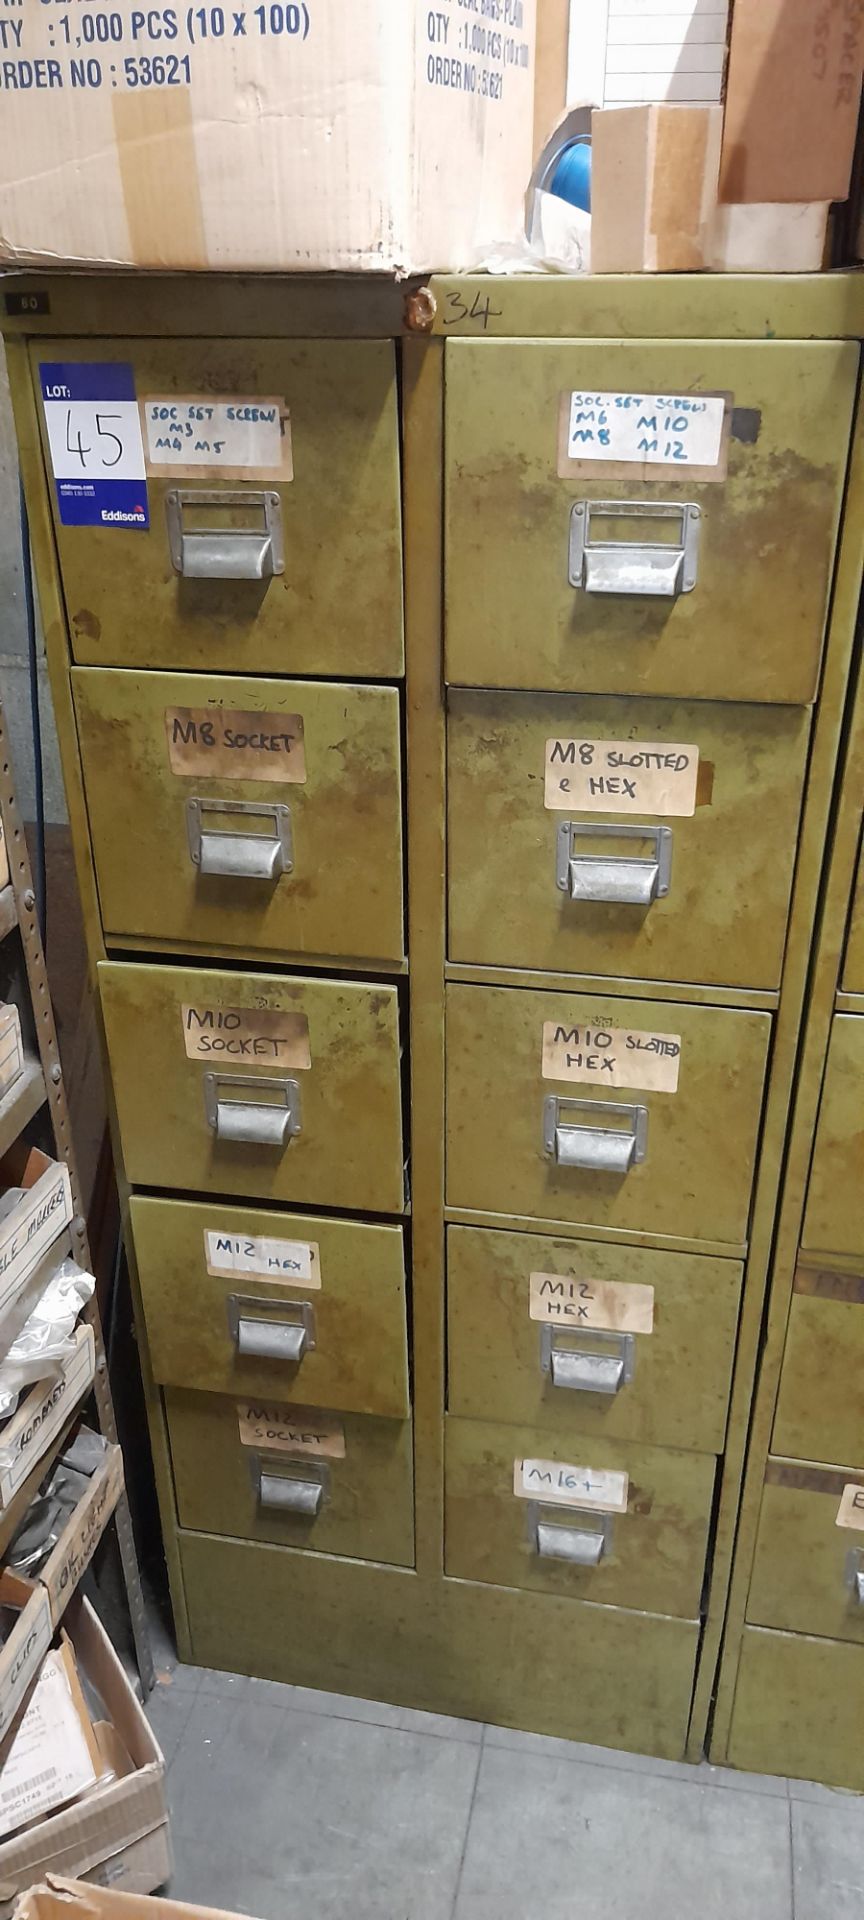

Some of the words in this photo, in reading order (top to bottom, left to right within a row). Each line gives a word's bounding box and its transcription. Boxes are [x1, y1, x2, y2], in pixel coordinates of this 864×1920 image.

[131, 9, 178, 40] PCS
[187, 7, 225, 44] (10
[232, 12, 247, 36] x
[254, 3, 310, 41] 100)
[427, 11, 450, 44] QTY
[0, 59, 64, 89] RDER
[70, 59, 102, 88] NO
[124, 54, 191, 87] 53621
[427, 54, 462, 89] ORDER
[463, 62, 475, 93] NO
[443, 291, 502, 329] 34
[46, 385, 71, 398] LOT:
[615, 396, 643, 409] SET
[151, 406, 178, 420] SOC
[188, 406, 214, 420] SET
[226, 407, 276, 423] SCREW
[575, 410, 608, 425] M6
[636, 416, 689, 432] M10
[66, 409, 123, 467] 45
[169, 422, 194, 437] M3
[194, 441, 226, 454] M5
[572, 428, 610, 446] M8
[637, 438, 688, 459] M12
[101, 510, 146, 522] Eddisons
[172, 718, 216, 746] M8
[223, 729, 295, 753] SOCKET
[550, 741, 595, 765] M8
[607, 751, 689, 771] SLOTTED
[589, 776, 637, 799] HEX
[187, 1008, 241, 1030] M10
[197, 1036, 288, 1057] SOCKET
[554, 1026, 613, 1048] M10
[625, 1035, 680, 1058] SLOTTED
[566, 1053, 617, 1072] HEX
[216, 1239, 256, 1257] M12
[268, 1258, 302, 1270] HEX
[539, 1280, 594, 1300] M12
[547, 1302, 588, 1318] HEX
[246, 1408, 297, 1427] M12
[255, 1428, 329, 1444] SOCKET
